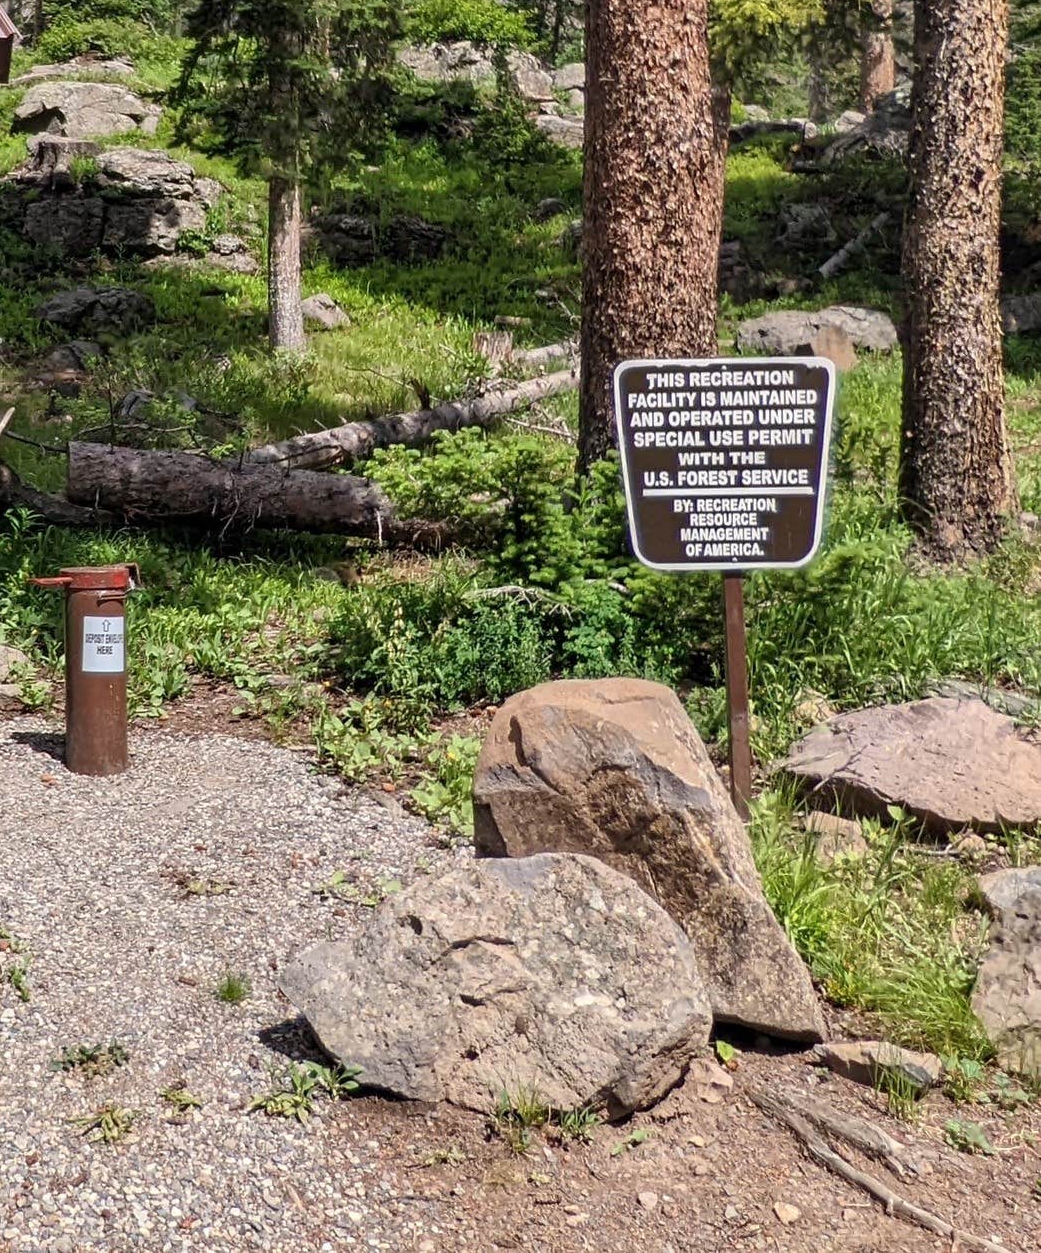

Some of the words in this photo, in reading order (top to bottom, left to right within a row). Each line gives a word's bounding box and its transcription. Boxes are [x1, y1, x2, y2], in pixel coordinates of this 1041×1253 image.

[646, 373, 685, 389] THIS
[689, 371, 794, 387] RECREATION
[628, 393, 697, 408] FACILITY
[701, 392, 716, 407] IS
[720, 390, 818, 406] MAINTAINED
[630, 412, 664, 427] AND
[668, 410, 754, 426] OPERATED
[758, 409, 816, 425] UNDER
[633, 431, 705, 447] SPECIAL
[709, 431, 744, 445] USE
[748, 429, 814, 445] PERMIT
[678, 452, 724, 466] WITH
[729, 451, 766, 465] THE
[643, 471, 674, 487] U.S.
[677, 470, 738, 486] FOREST
[741, 469, 808, 485] SERVICE
[673, 499, 694, 513] BY:
[696, 498, 777, 513] RECREATION
[690, 513, 758, 527] RESOURCE
[680, 527, 769, 541] MANAGEMENT
[686, 543, 704, 556] OF
[703, 542, 764, 556] AMERICA.
[97, 646, 113, 655] HERE
